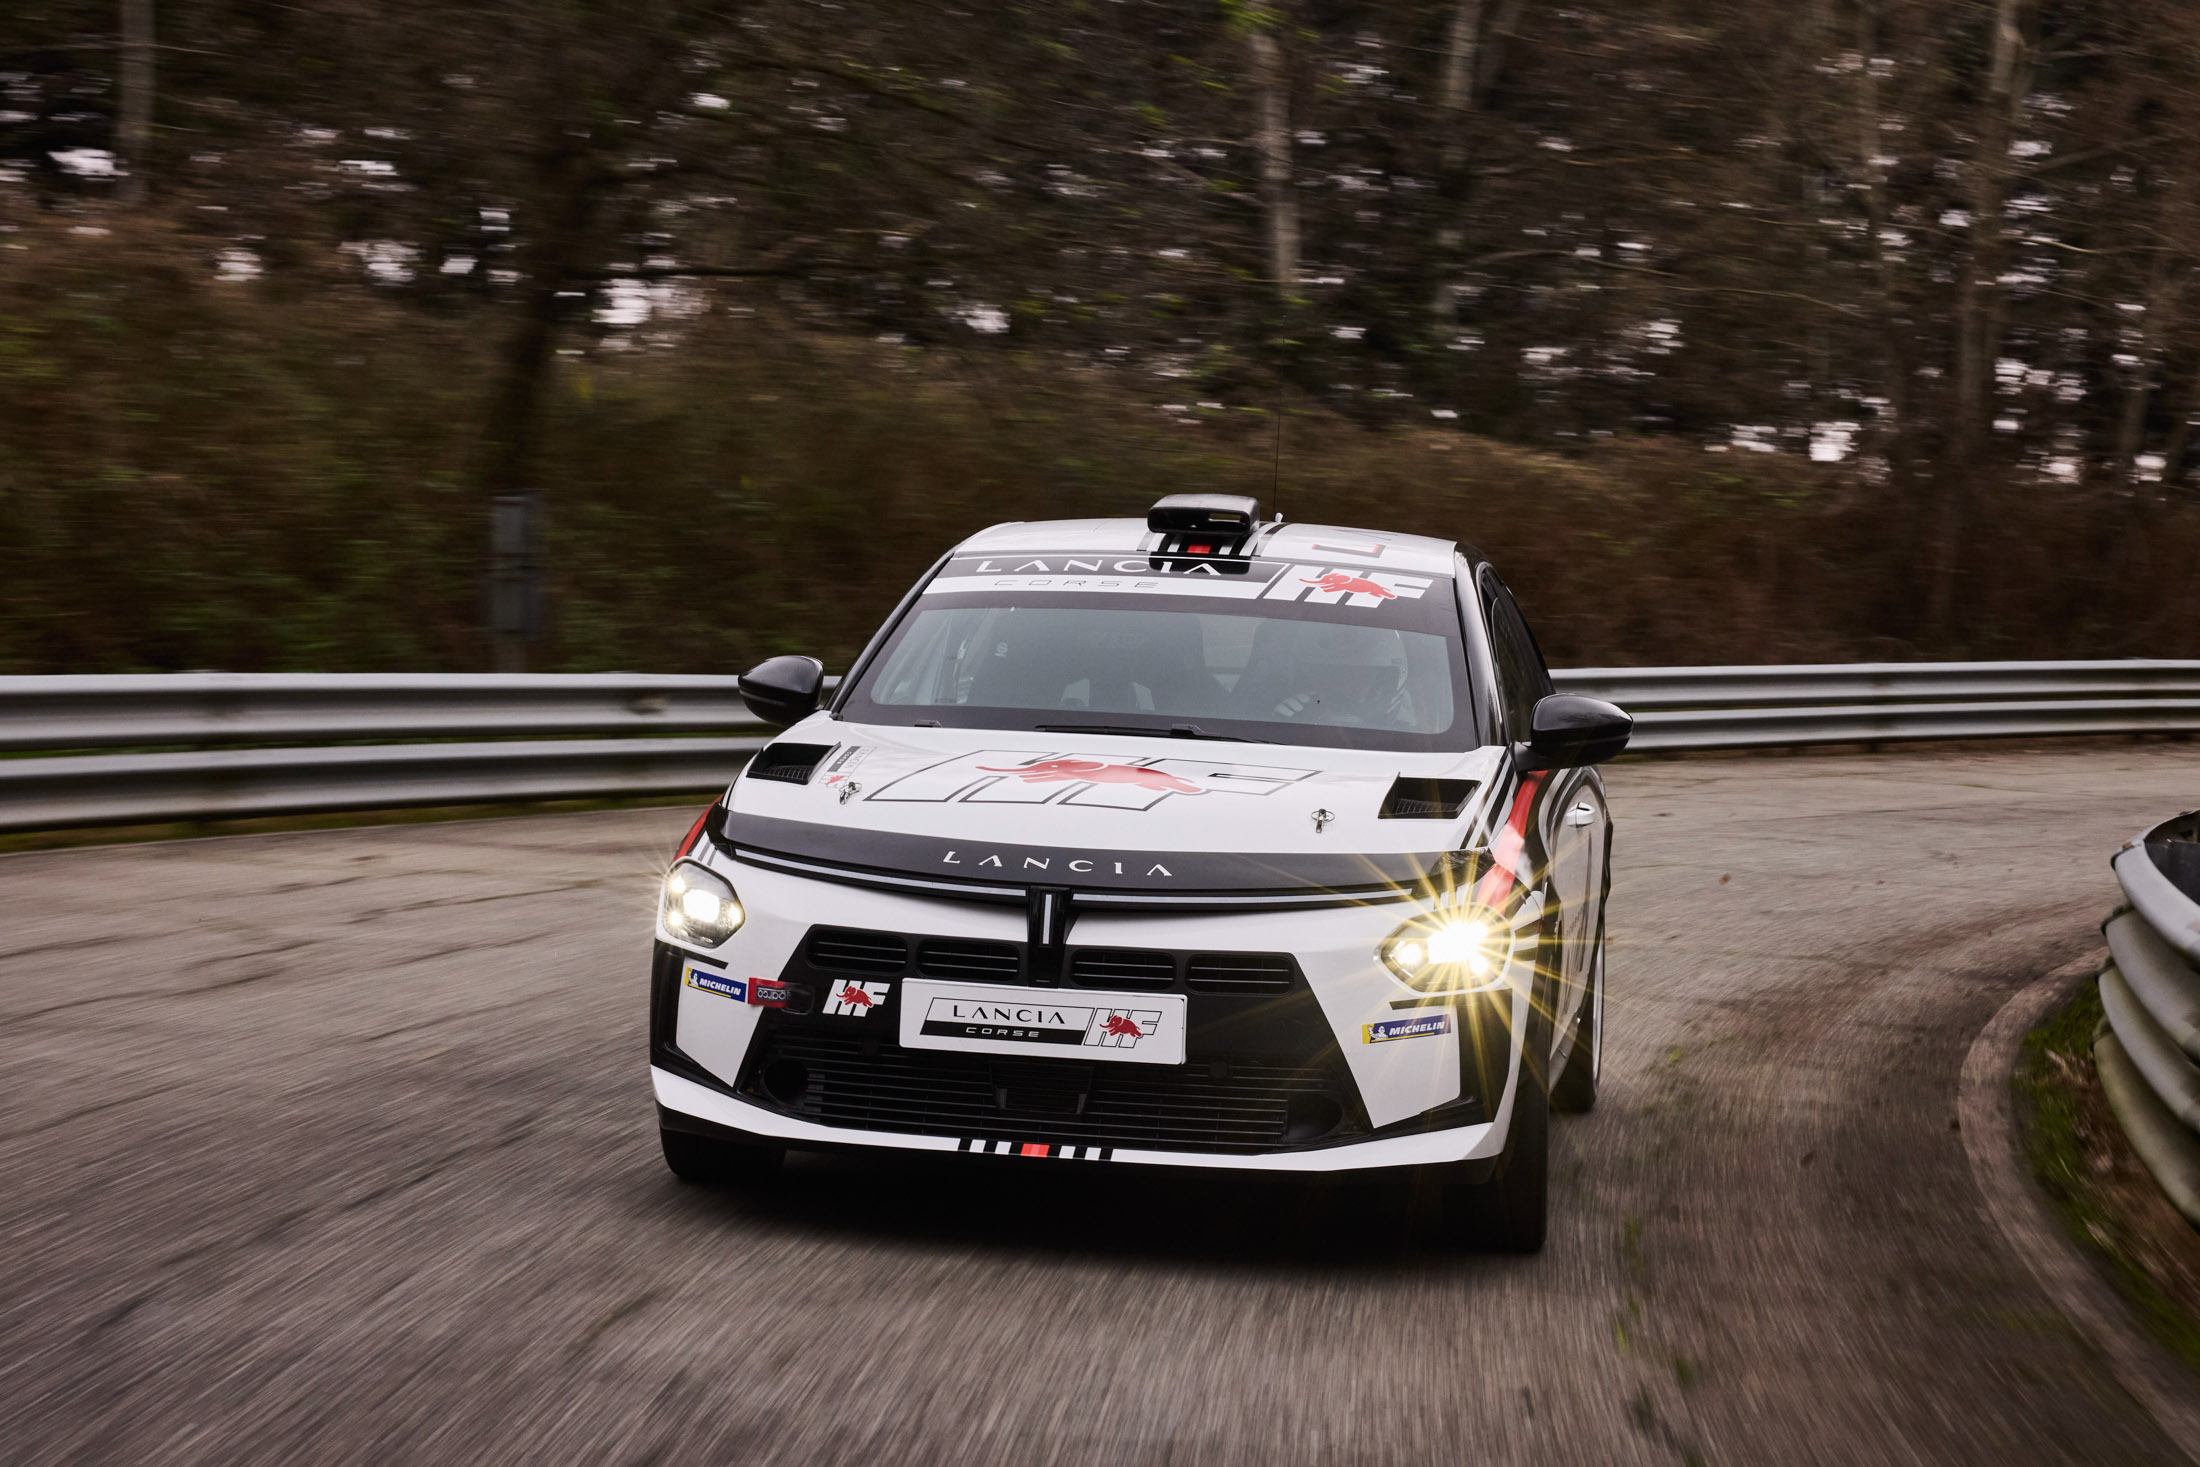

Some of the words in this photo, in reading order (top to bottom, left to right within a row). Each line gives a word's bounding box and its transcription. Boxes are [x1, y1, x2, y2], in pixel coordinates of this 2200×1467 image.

[975, 559, 1222, 576] LANCIA
[994, 579, 1160, 589] CORSE
[942, 850, 1173, 877] LANCIA
[699, 977, 742, 996] MICHELIN
[953, 1004, 1066, 1025] LANCIA
[965, 1026, 1040, 1038] CORSE
[1389, 1021, 1446, 1036] MICHELIN
